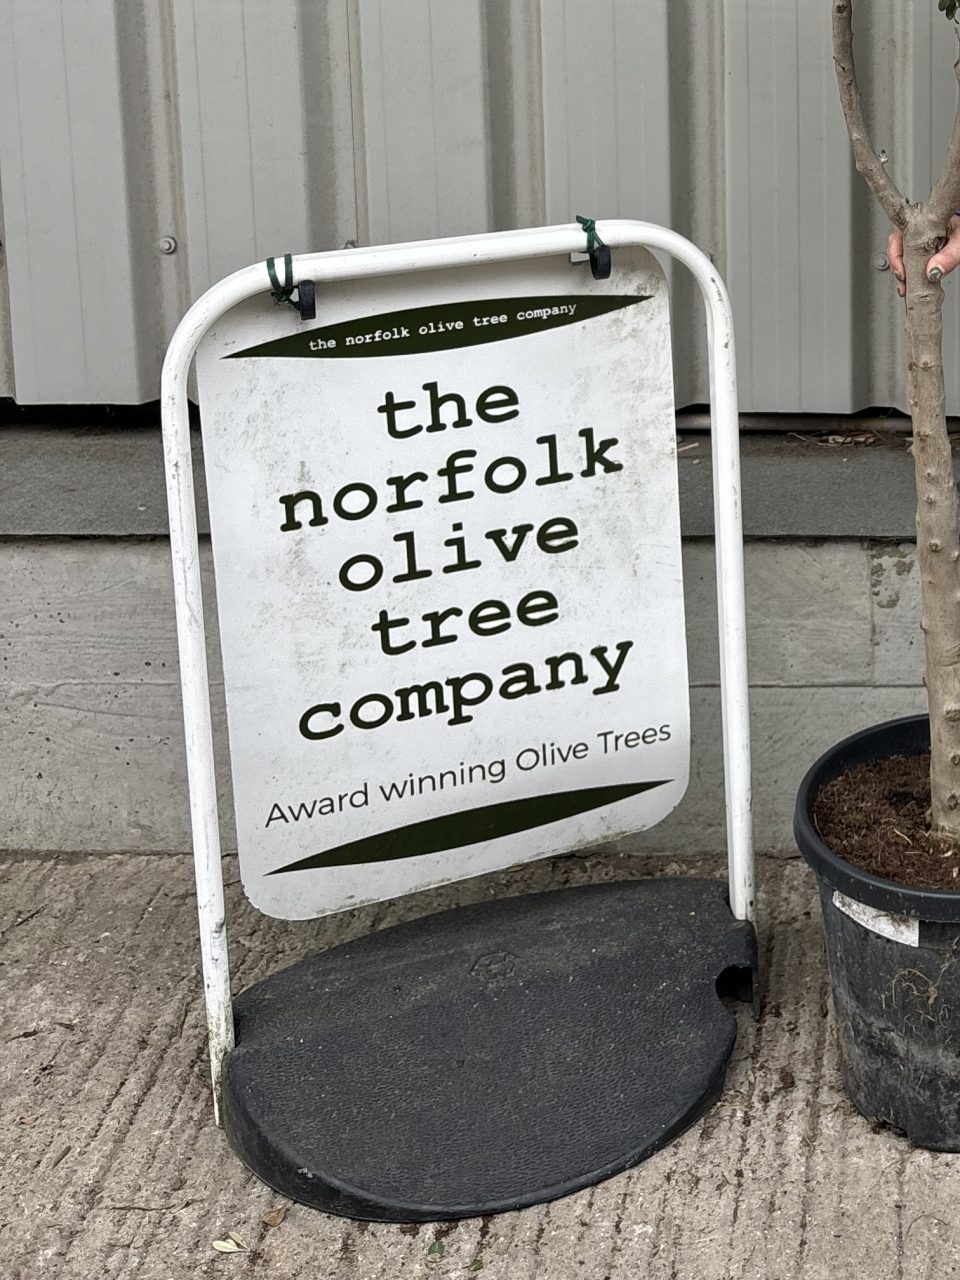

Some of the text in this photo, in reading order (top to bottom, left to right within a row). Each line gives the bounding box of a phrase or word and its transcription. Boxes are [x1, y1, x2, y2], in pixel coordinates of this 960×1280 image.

[308, 301, 578, 352] the norfolk olive tree company
[378, 382, 520, 439] the
[279, 427, 624, 532] norfolk
[338, 517, 579, 592] olive
[371, 590, 559, 656] tree
[298, 641, 634, 741] company
[265, 724, 672, 828] Award winning Olive Trees
